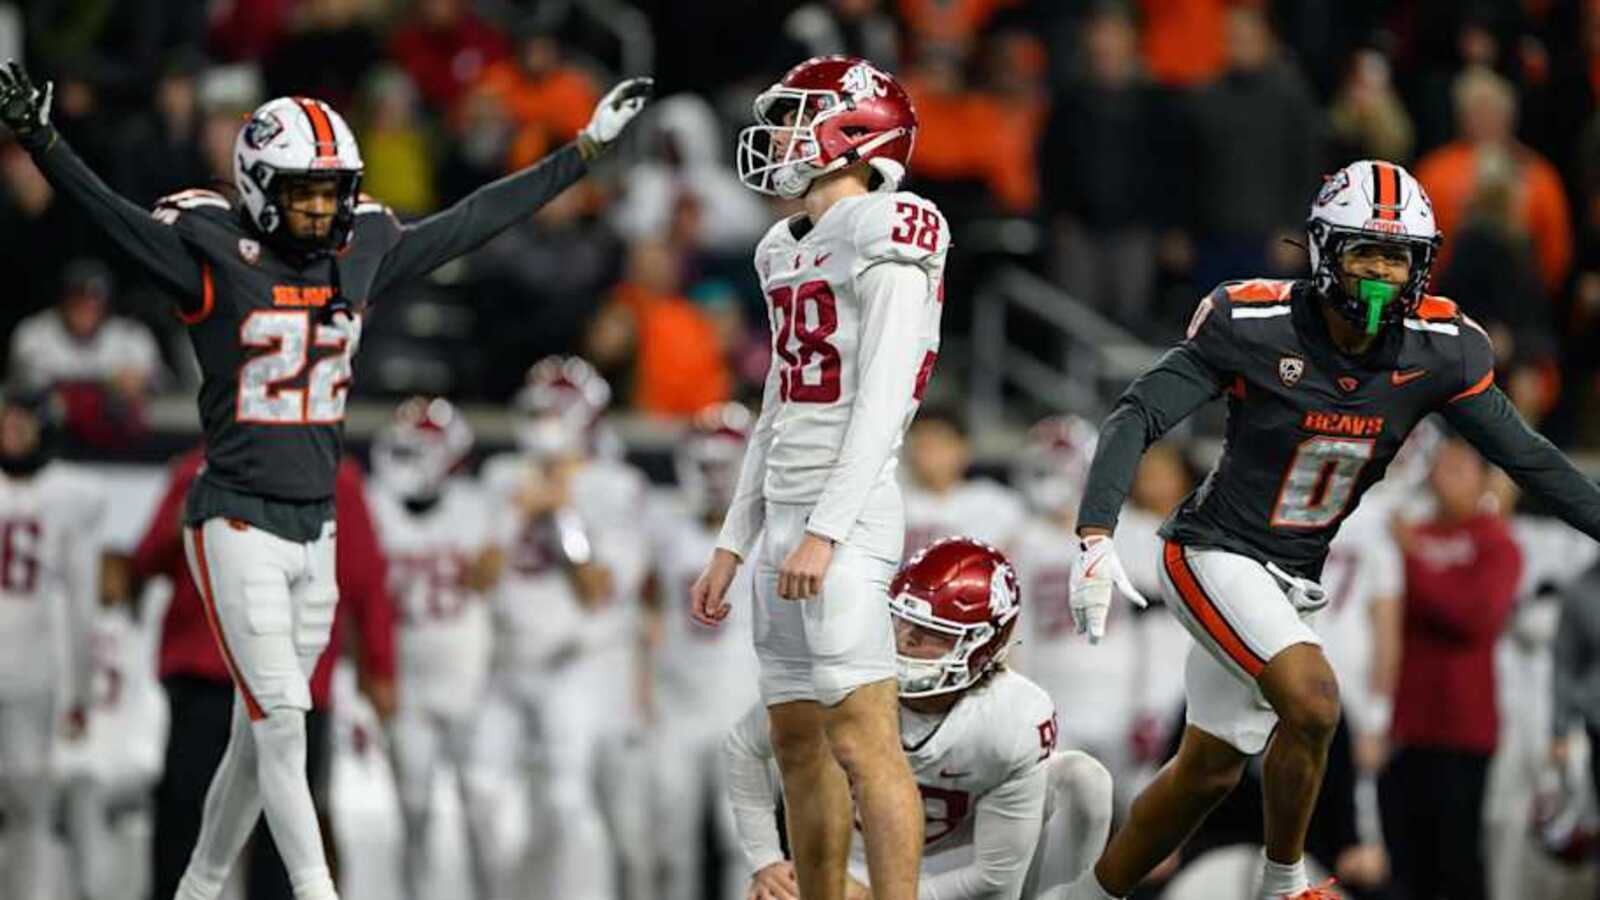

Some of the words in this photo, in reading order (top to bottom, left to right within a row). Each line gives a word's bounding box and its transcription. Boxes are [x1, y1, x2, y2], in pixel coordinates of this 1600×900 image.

[891, 202, 940, 254] 38
[236, 308, 353, 425] 22
[767, 279, 842, 404] 38
[1304, 412, 1385, 435] BEAVS
[1269, 434, 1376, 527] 0
